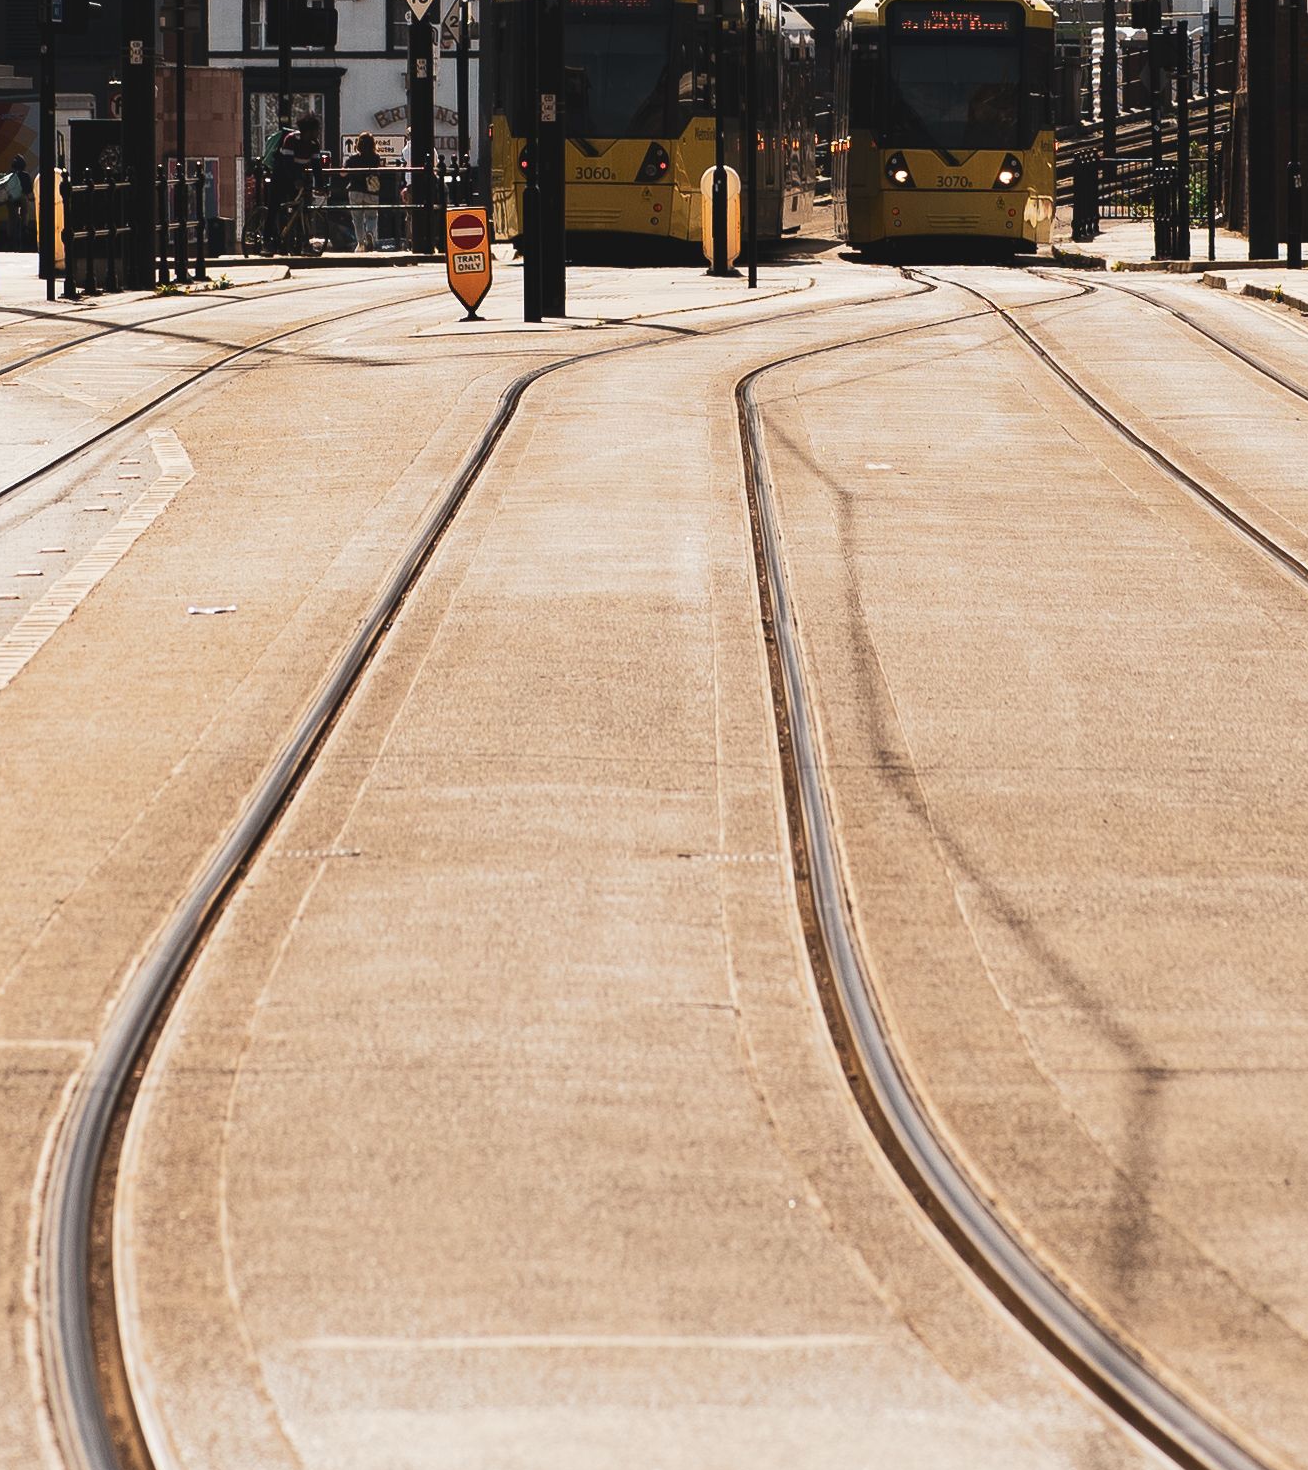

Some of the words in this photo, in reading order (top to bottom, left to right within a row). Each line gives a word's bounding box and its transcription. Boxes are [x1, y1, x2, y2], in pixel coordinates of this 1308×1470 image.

[449, 16, 459, 27] 2
[457, 254, 481, 262] TRAM
[457, 263, 481, 271] ONLY
